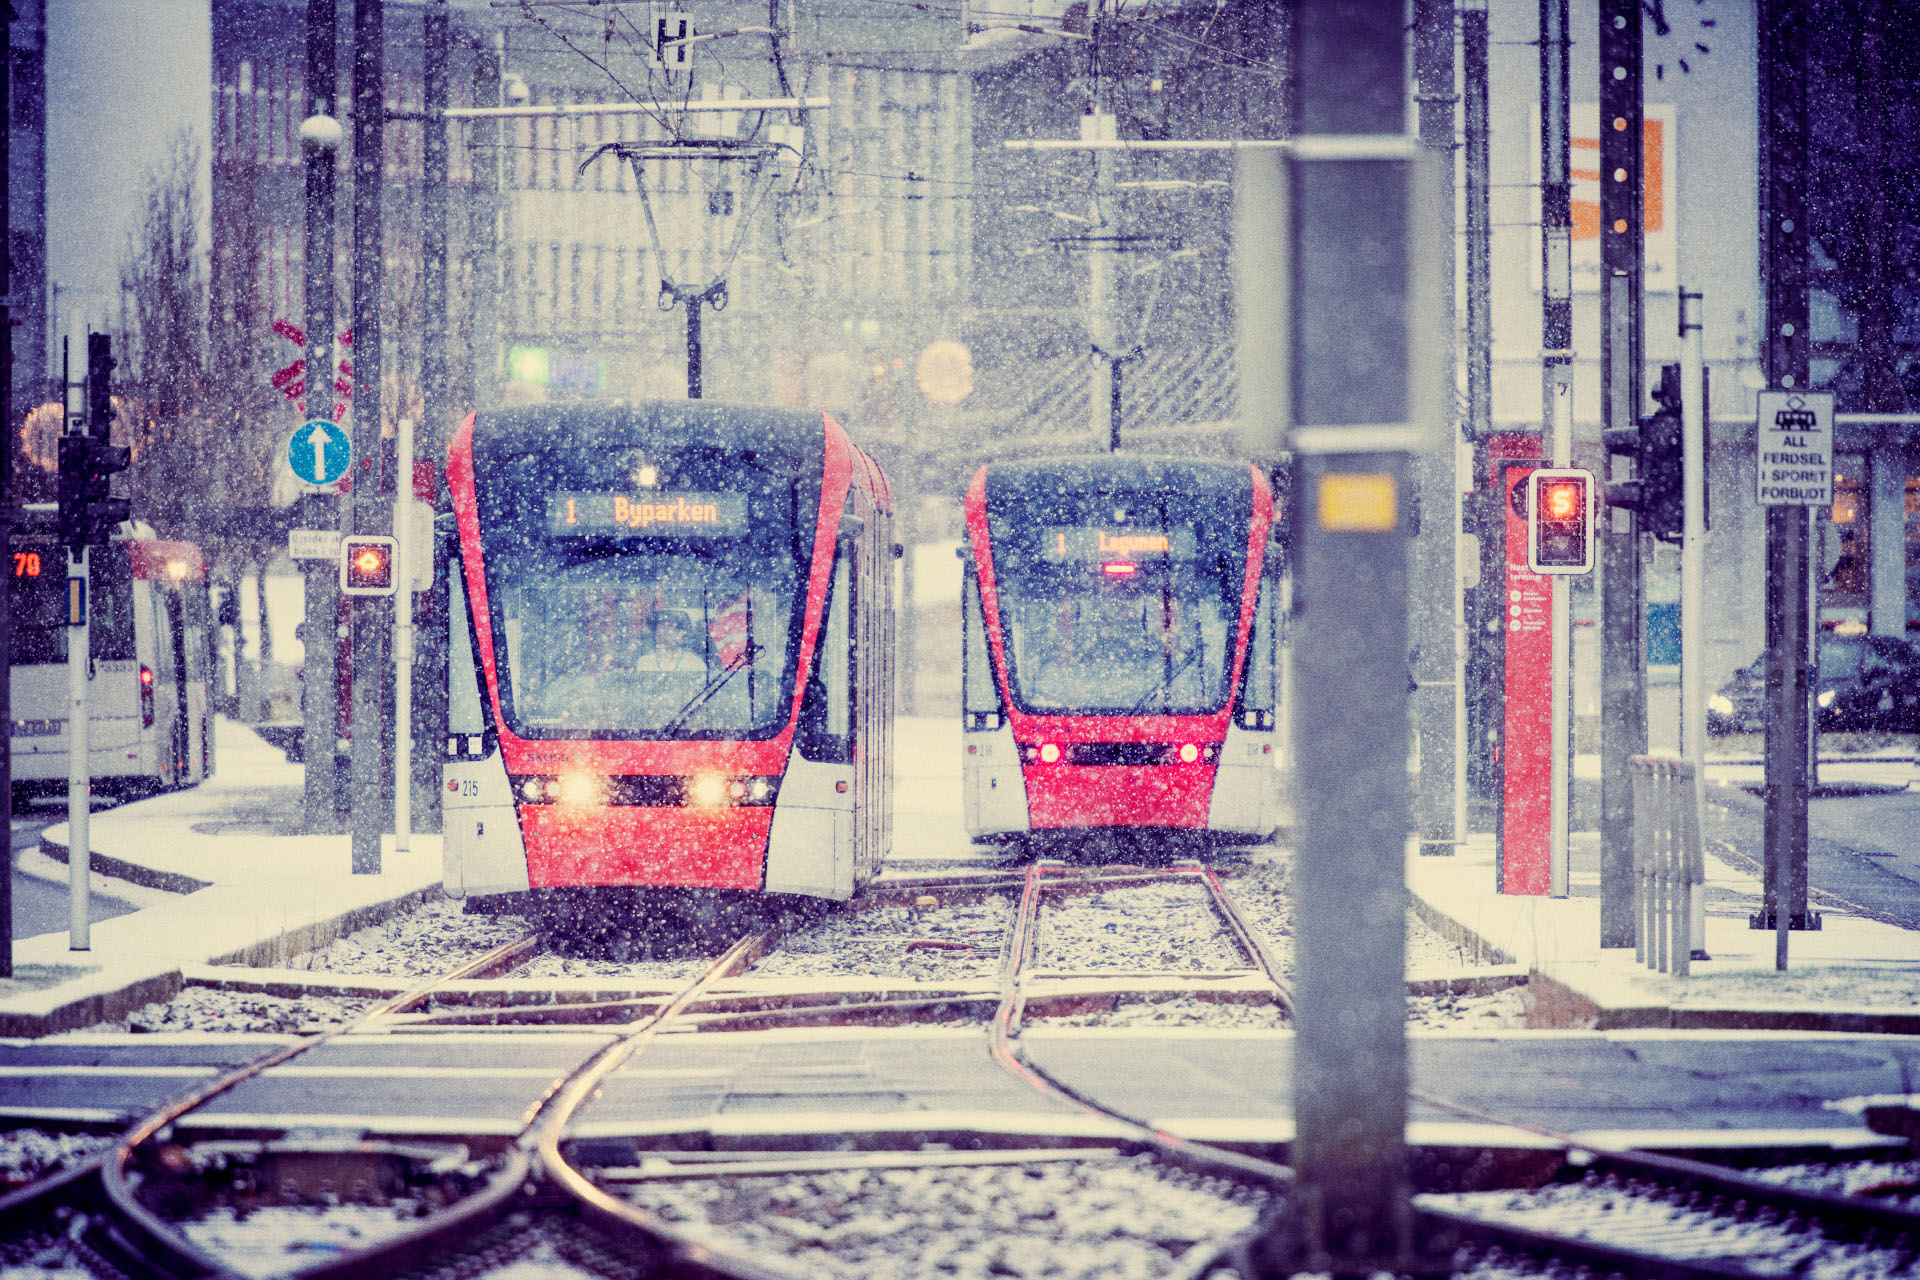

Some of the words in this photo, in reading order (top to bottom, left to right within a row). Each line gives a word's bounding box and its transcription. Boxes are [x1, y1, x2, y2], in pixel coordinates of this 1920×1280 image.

[1783, 436, 1807, 447] ALL
[1763, 452, 1826, 466] FERDSEL
[1772, 469, 1827, 482] SPORET
[1761, 486, 1826, 499] FORBUDT
[565, 499, 577, 523] 1
[614, 496, 718, 527] Byparken
[13, 553, 41, 577] 70
[463, 780, 479, 797] 215
